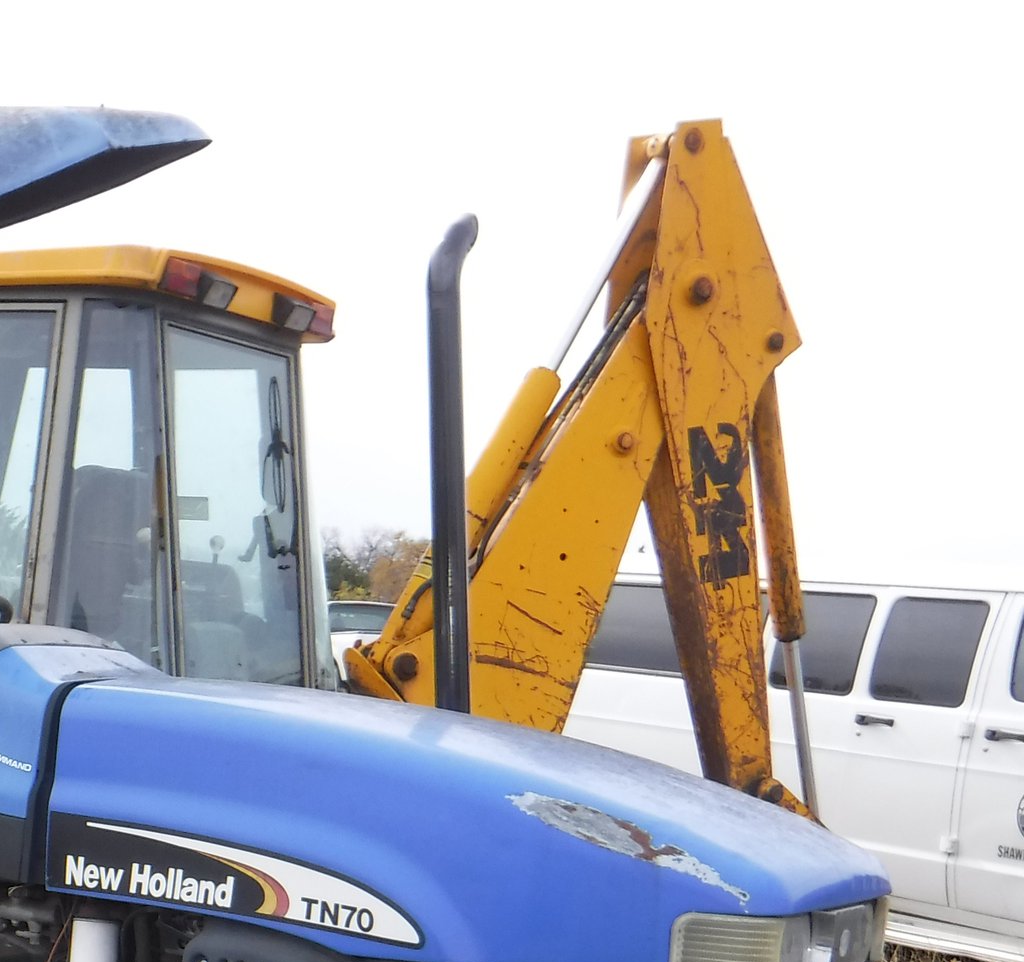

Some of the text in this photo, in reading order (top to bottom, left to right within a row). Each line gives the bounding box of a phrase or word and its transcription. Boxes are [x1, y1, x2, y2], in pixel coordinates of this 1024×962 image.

[997, 844, 1024, 861] SHAW
[65, 855, 375, 934] New Holland TN70
